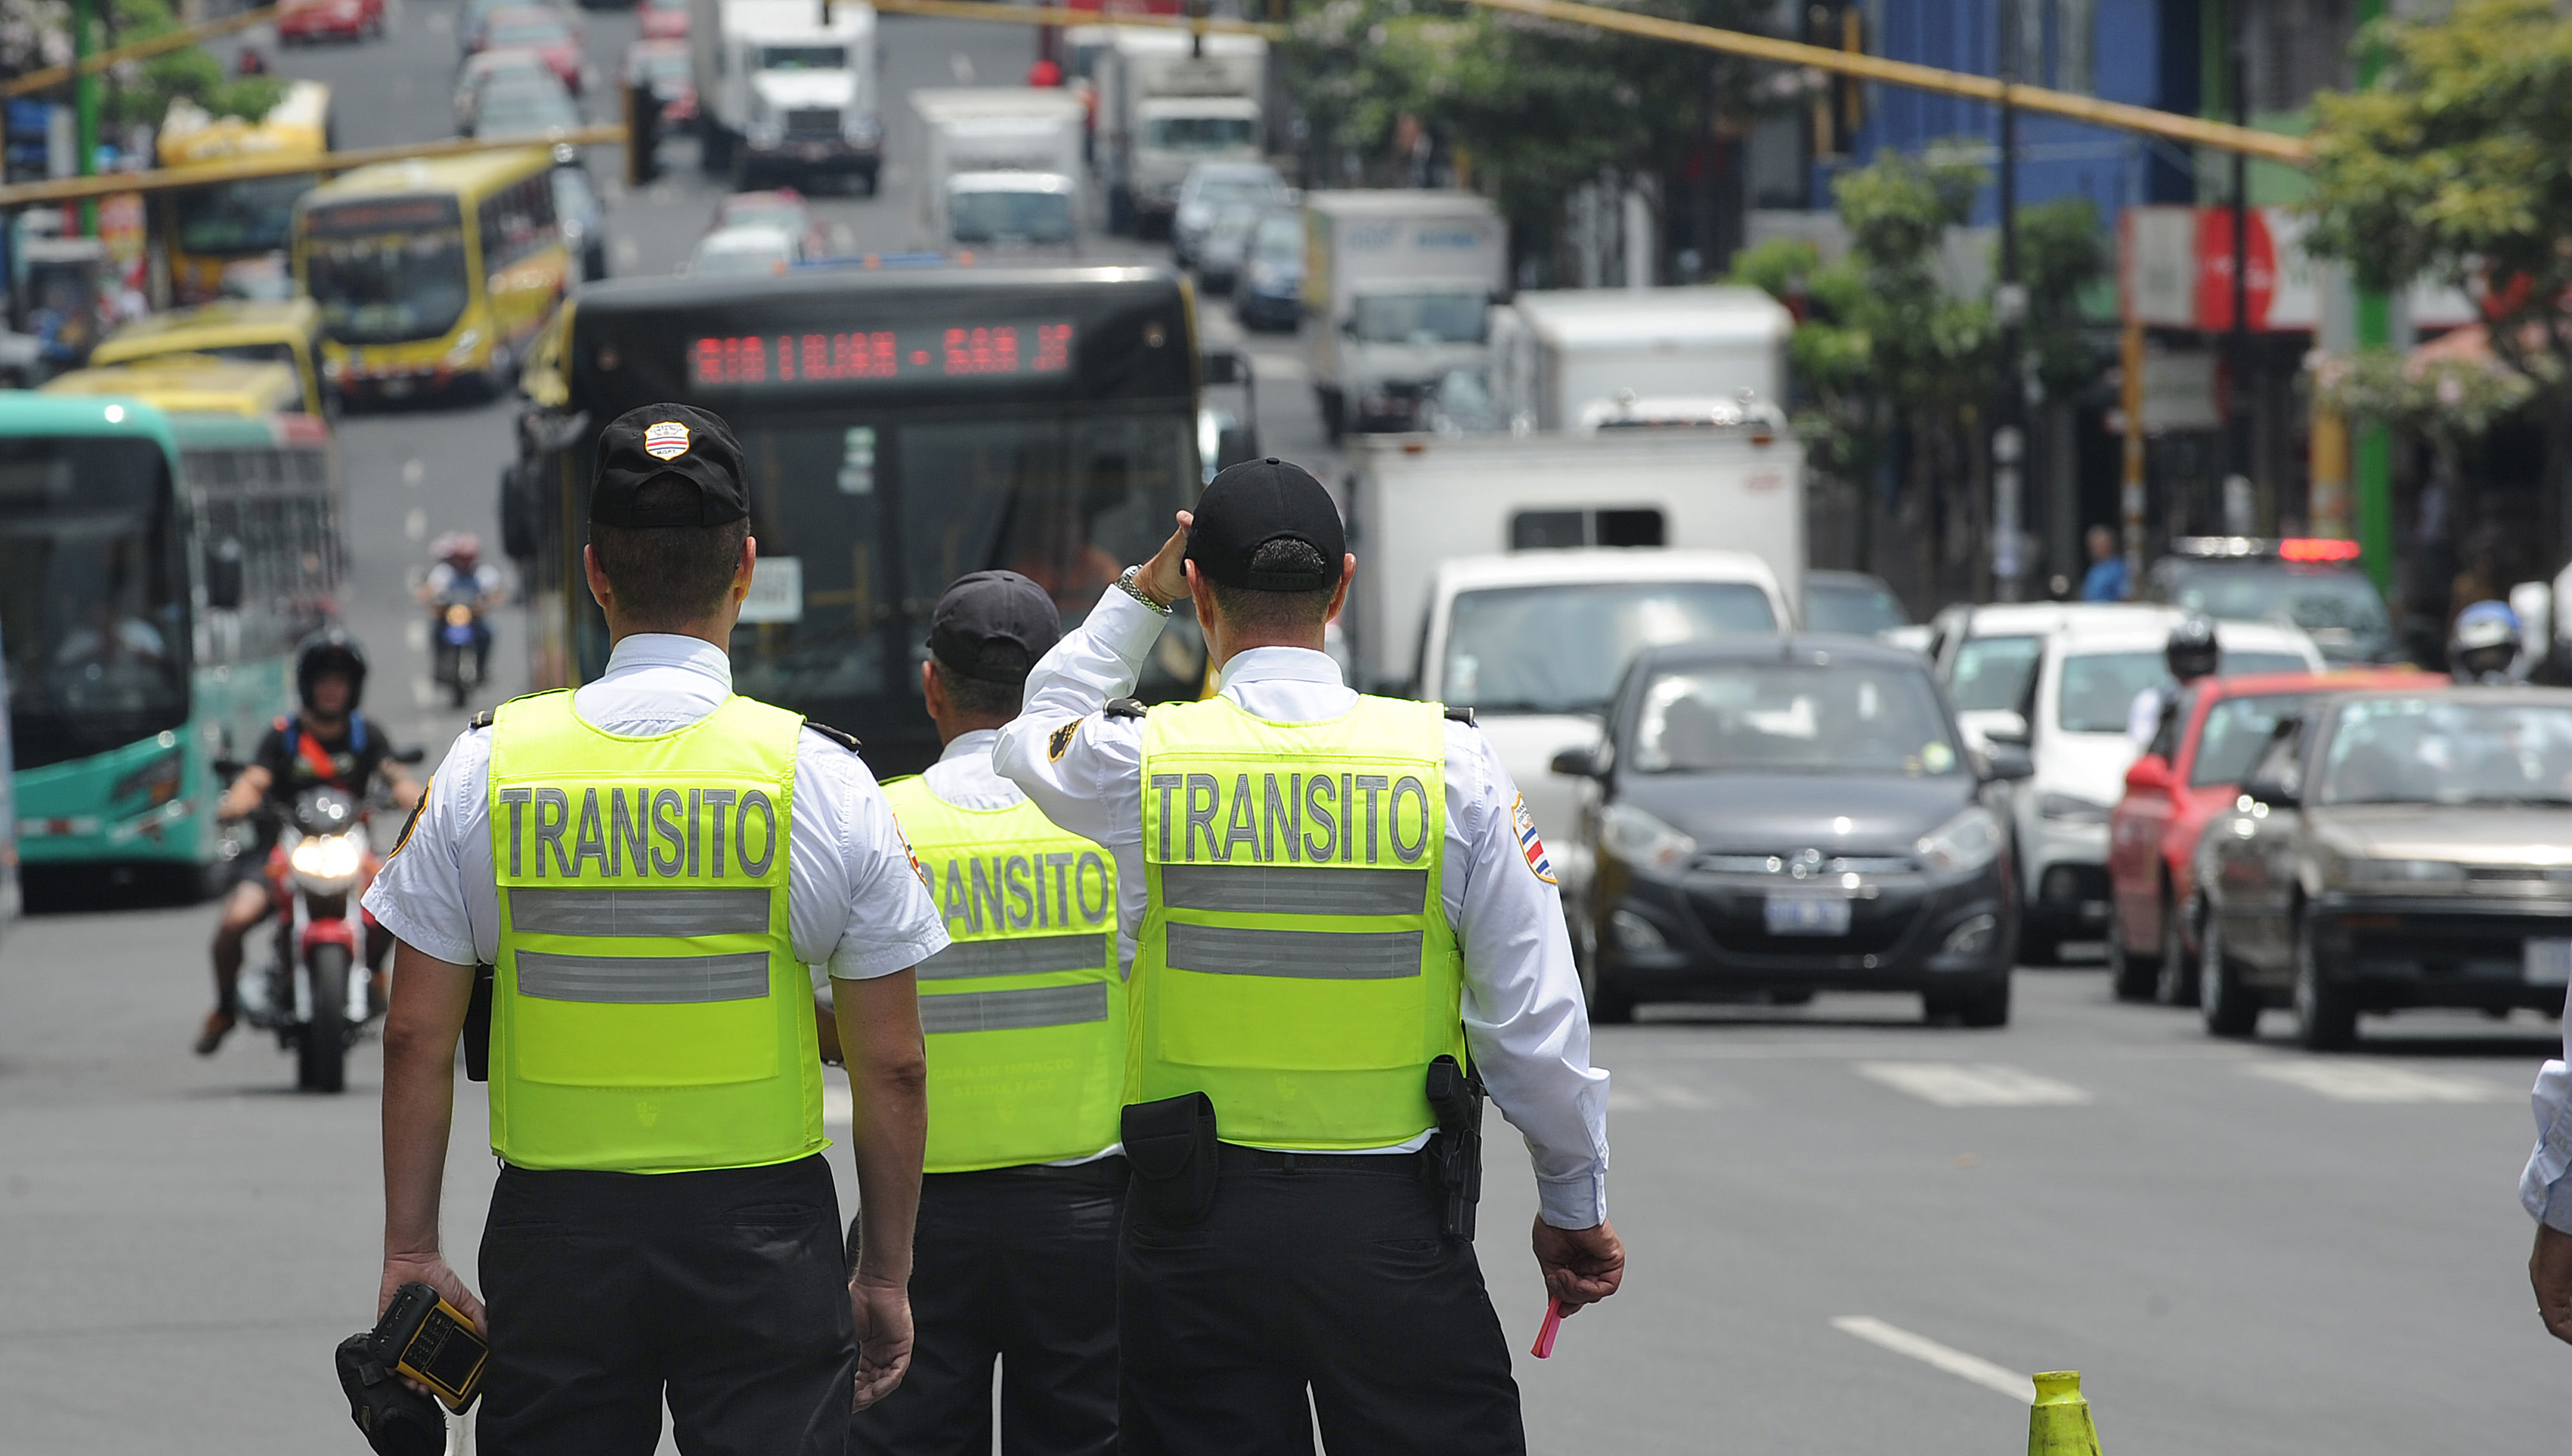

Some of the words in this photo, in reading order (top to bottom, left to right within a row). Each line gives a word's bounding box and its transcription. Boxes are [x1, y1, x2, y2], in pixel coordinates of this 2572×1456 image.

[499, 788, 776, 878] TRANSITO
[1150, 773, 1428, 863] TRANSITO
[932, 1067, 975, 1080] CARA
[978, 1065, 1000, 1077] DE
[1005, 1058, 1075, 1076] IMPACTO
[952, 1083, 1011, 1097] STRIKE
[1016, 1077, 1056, 1093] FACE
